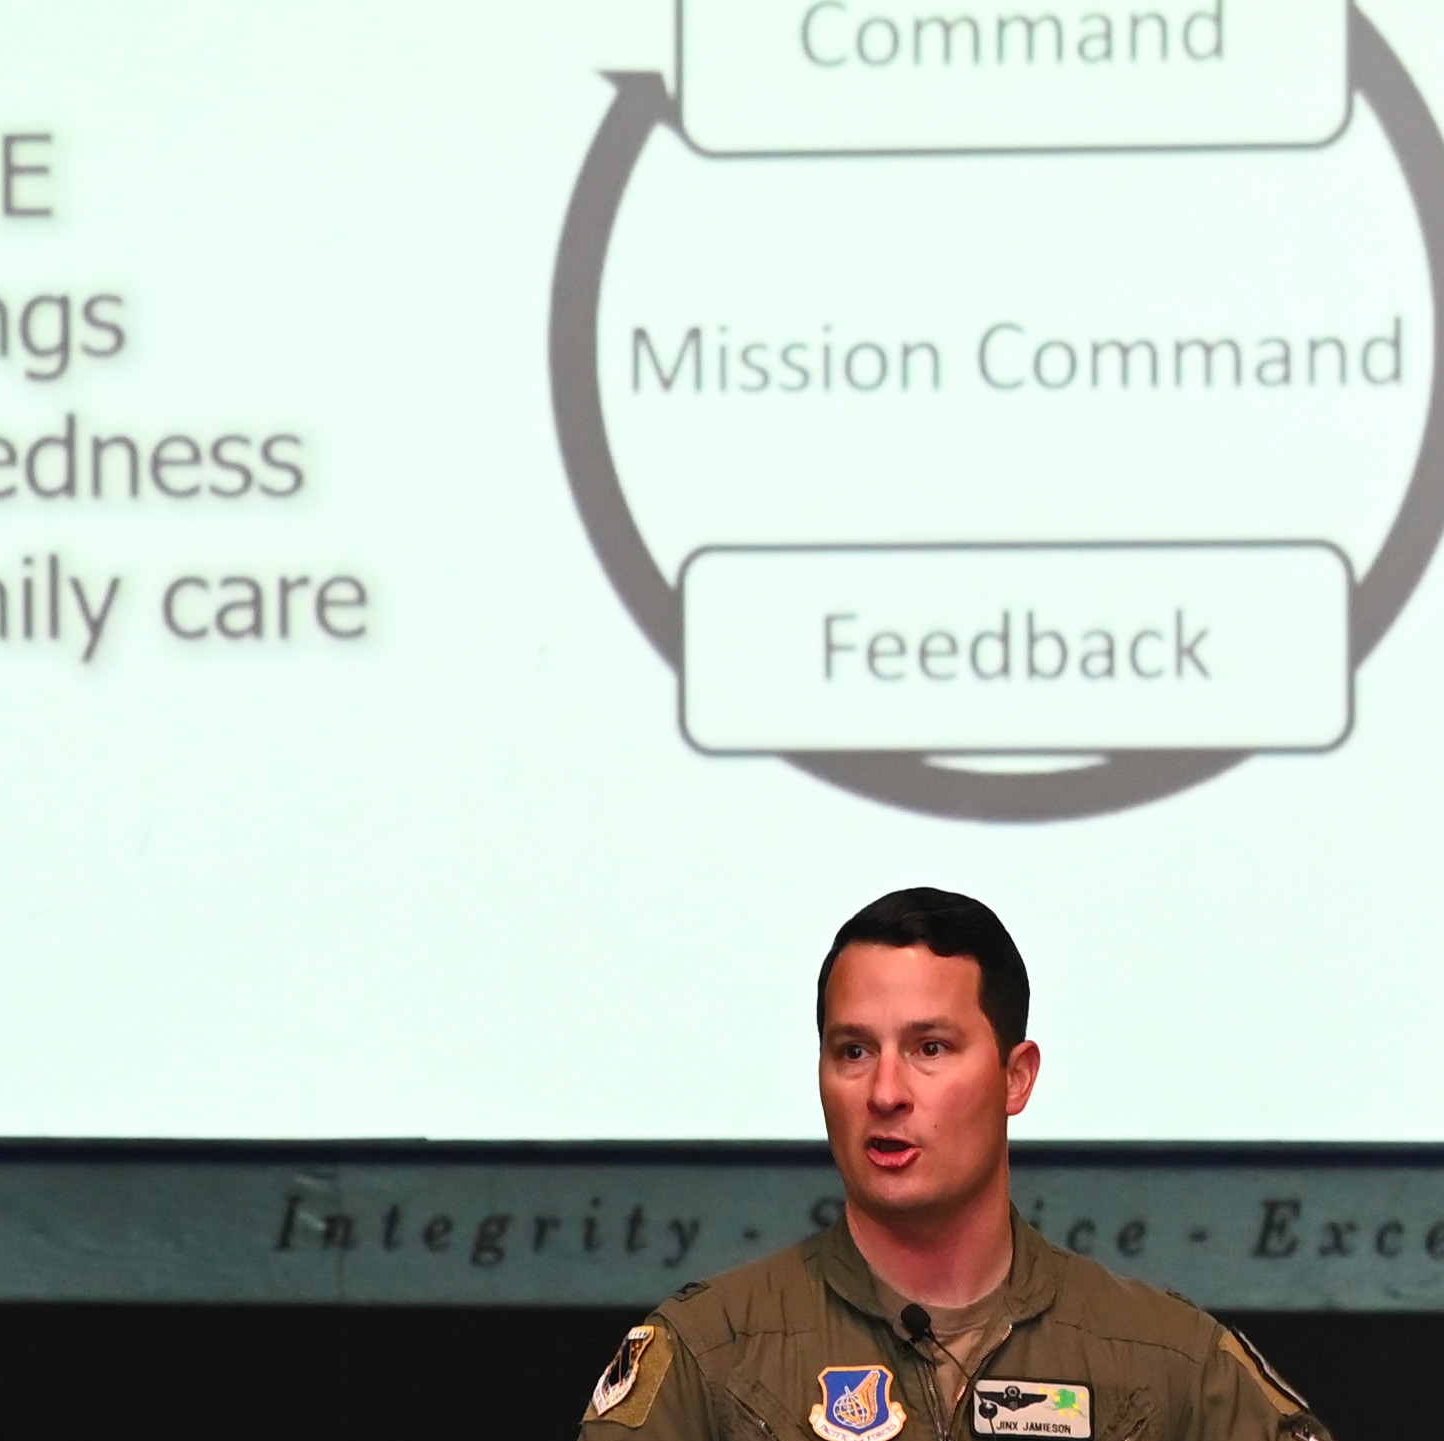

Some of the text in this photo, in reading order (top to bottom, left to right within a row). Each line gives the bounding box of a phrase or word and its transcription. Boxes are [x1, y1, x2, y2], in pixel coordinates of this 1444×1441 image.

[798, 0, 1226, 68] Command
[630, 315, 1404, 394] Mission Command
[160, 573, 370, 642] care
[822, 609, 1211, 682] Feedback
[274, 1195, 700, 1268] Integrity
[996, 1421, 1072, 1434] JINX JAMIESON
